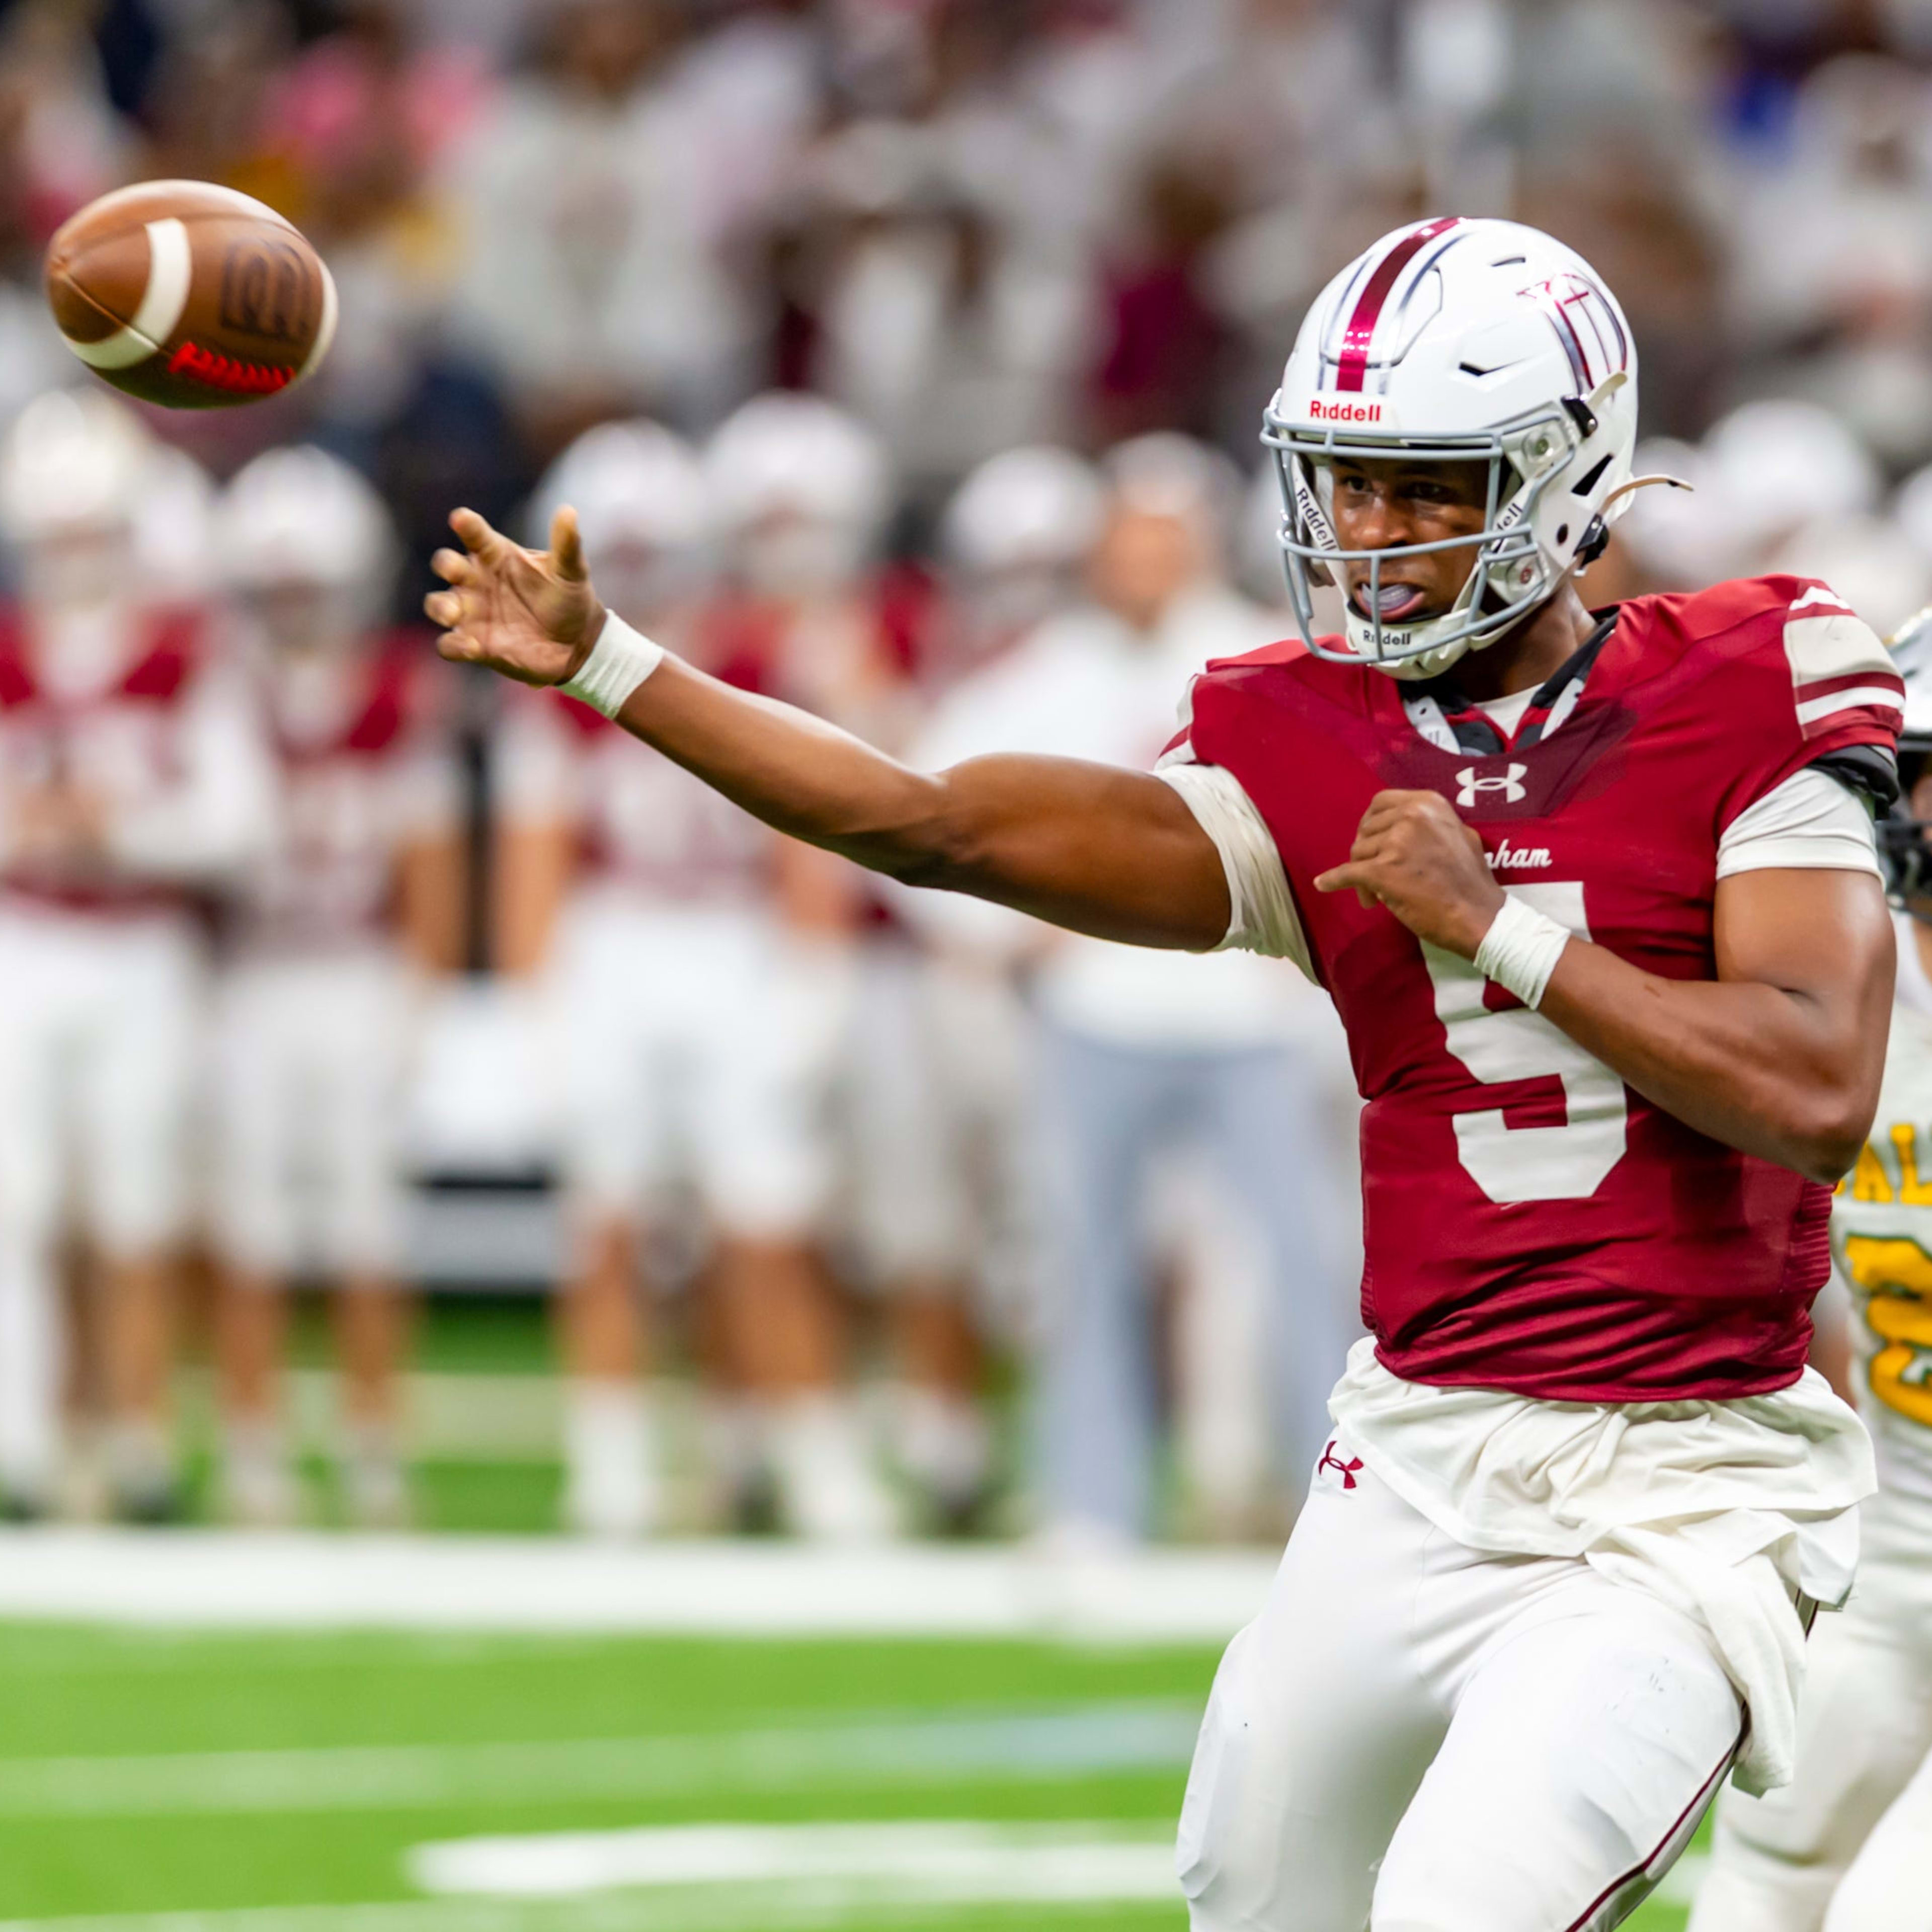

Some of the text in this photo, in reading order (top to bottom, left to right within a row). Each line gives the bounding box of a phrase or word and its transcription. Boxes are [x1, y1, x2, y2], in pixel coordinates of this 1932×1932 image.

[1310, 400, 1381, 421] Riddell
[1297, 487, 1337, 551] Riddell
[1363, 629, 1411, 645] Ridell
[1419, 881, 1627, 1203] 5
[1833, 1123, 1932, 1206] AL
